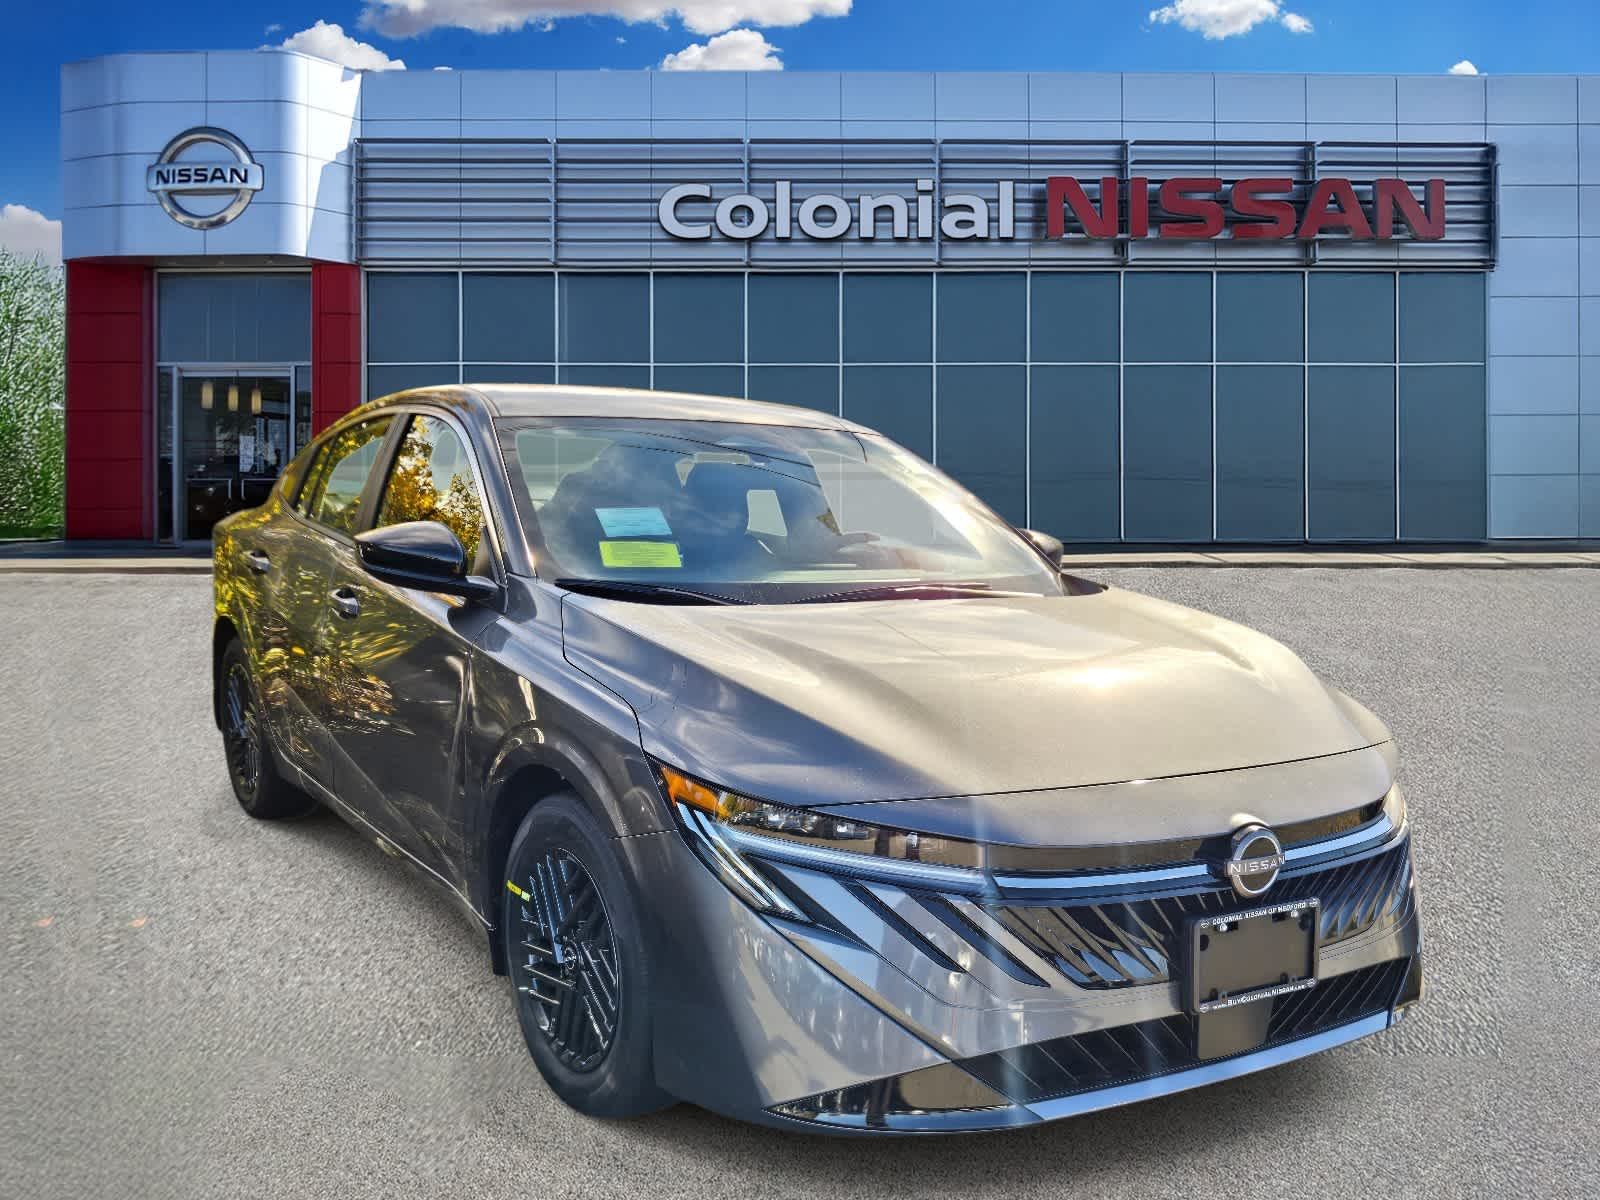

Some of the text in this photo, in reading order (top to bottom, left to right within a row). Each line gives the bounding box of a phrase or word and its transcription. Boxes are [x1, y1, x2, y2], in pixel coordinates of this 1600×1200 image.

[156, 167, 249, 185] NISSAN
[658, 176, 1446, 240] Colonial NISSAN
[1230, 856, 1285, 874] NISSAN
